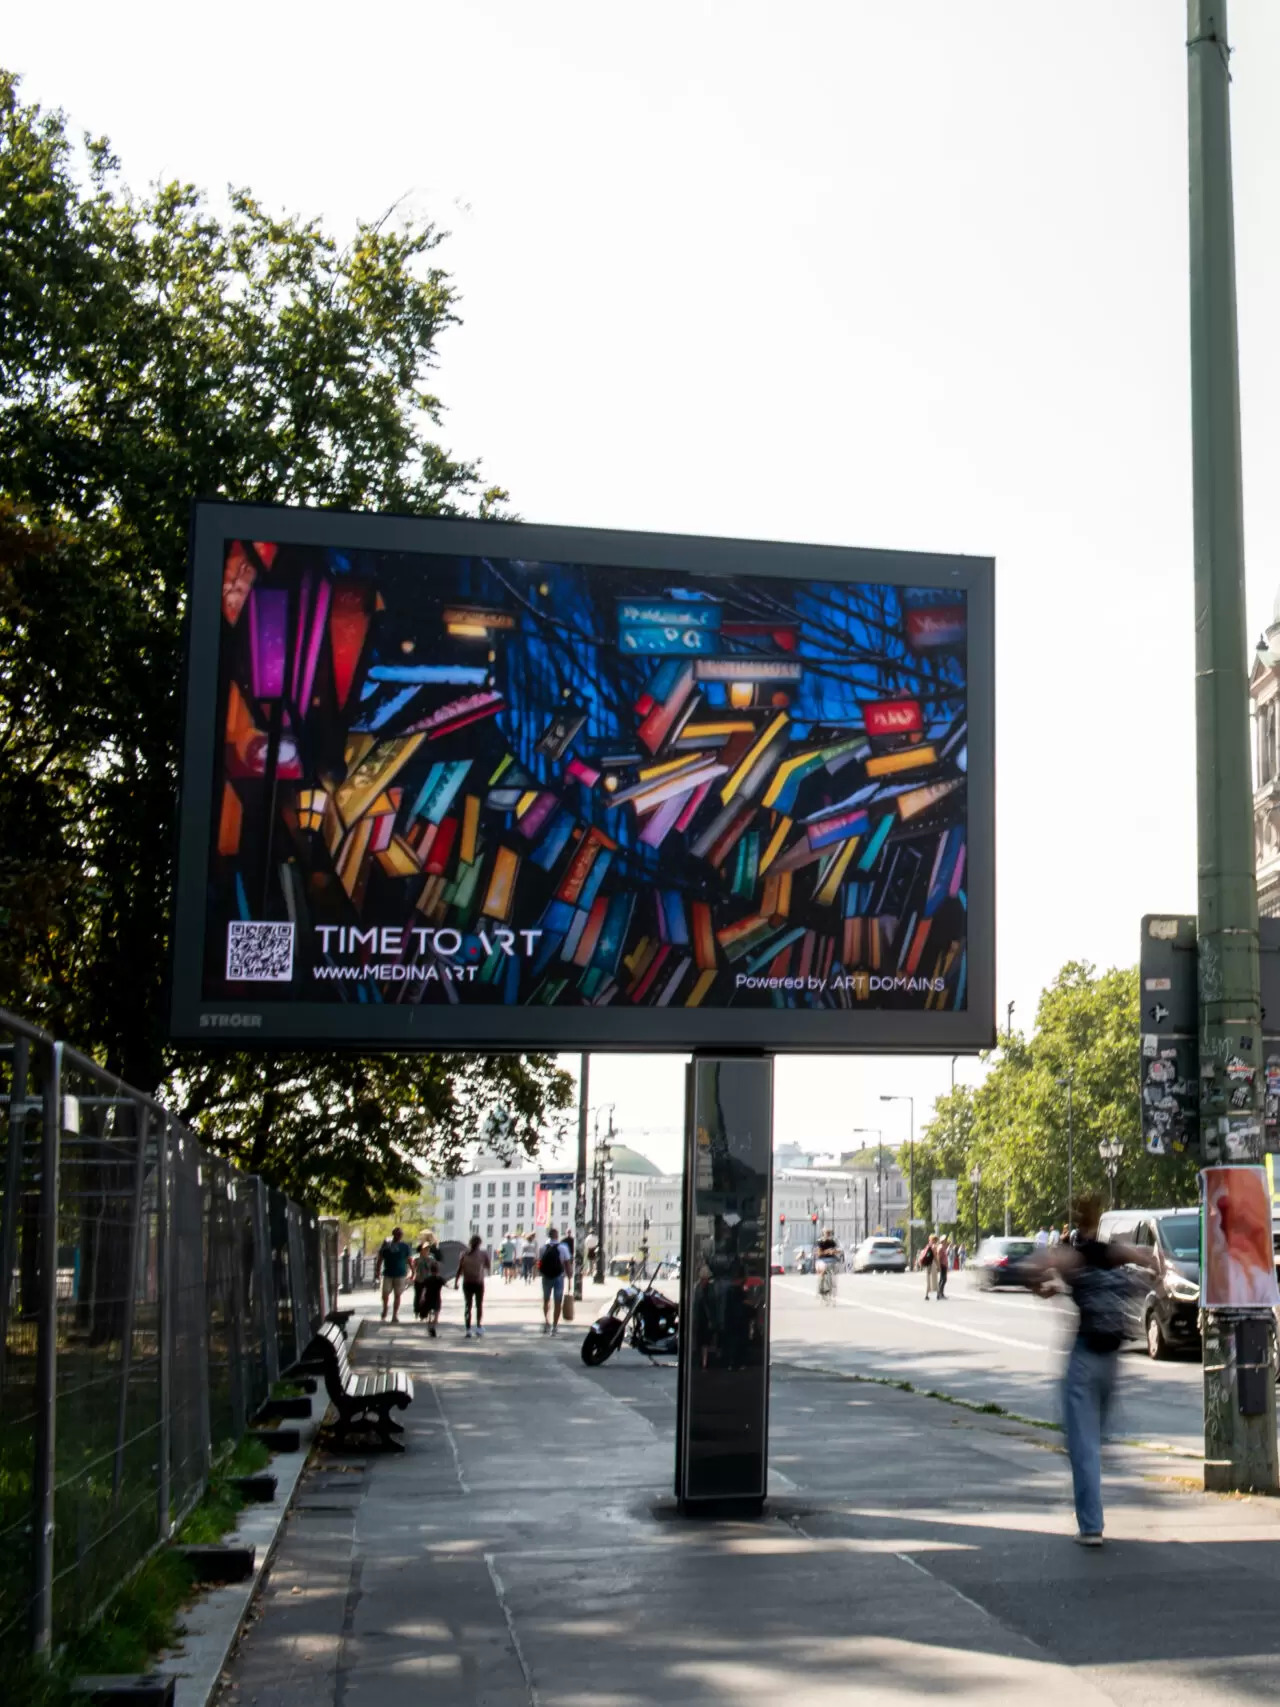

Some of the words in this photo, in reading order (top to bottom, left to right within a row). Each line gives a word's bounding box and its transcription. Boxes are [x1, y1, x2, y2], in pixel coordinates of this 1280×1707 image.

[314, 925, 404, 955] TIME
[411, 927, 462, 956] TO
[735, 972, 804, 990] Powered
[808, 975, 827, 993] by
[869, 975, 945, 992] DOMAINS
